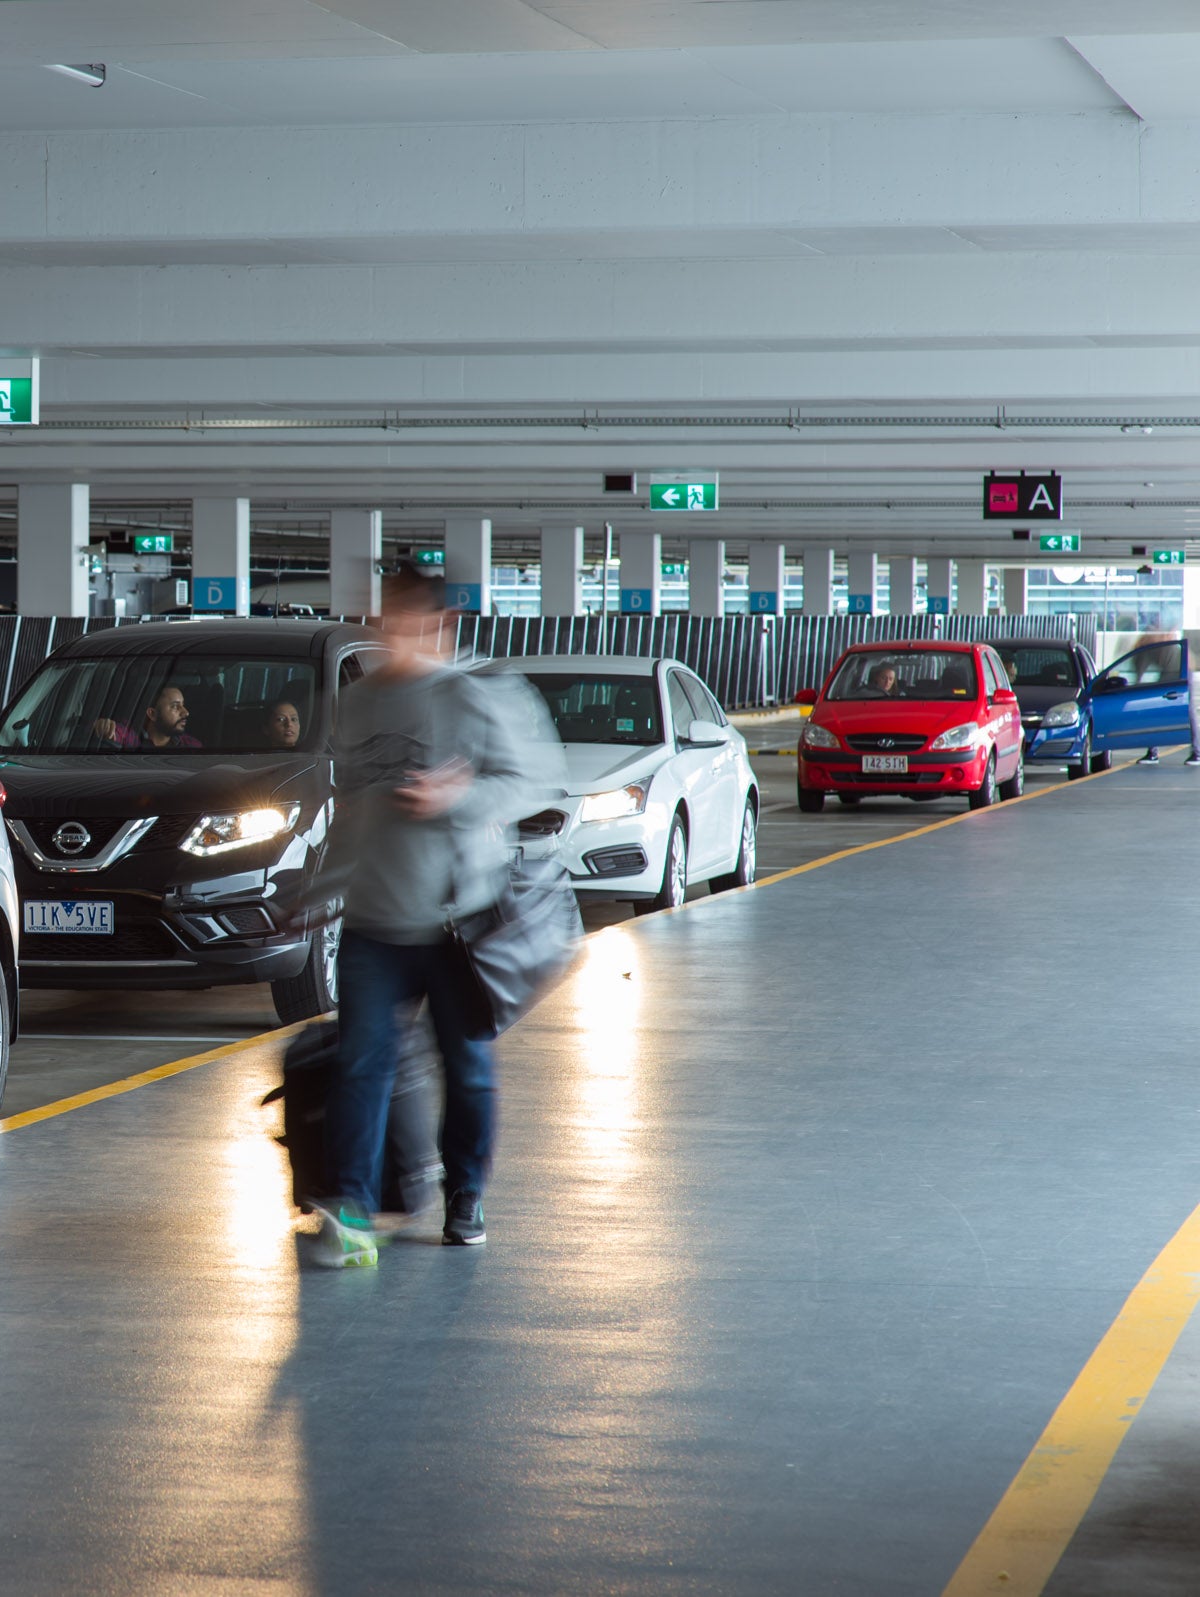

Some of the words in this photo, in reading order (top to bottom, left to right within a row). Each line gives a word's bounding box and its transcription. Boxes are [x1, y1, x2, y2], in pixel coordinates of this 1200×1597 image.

[1028, 483, 1055, 511] A
[207, 586, 224, 605] D
[457, 590, 471, 607] D
[630, 594, 642, 609] D
[758, 596, 769, 609] D
[76, 906, 109, 927] 5VE
